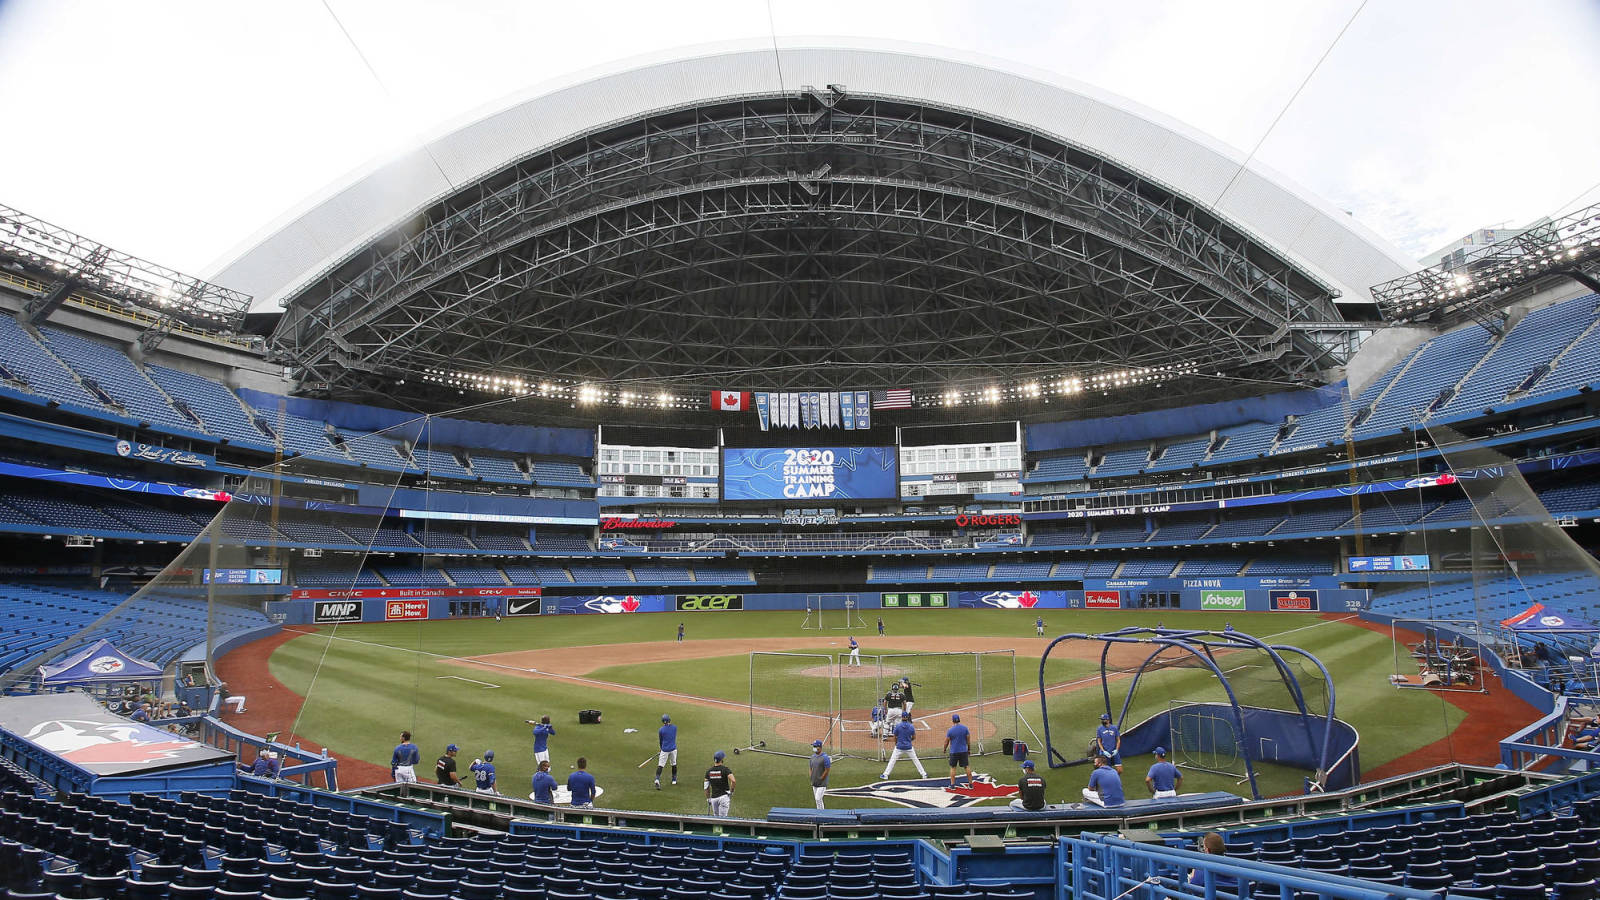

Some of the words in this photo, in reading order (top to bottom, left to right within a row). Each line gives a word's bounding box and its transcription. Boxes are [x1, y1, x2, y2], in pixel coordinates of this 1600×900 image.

[842, 408, 852, 416] 12
[856, 407, 869, 417] 32
[783, 449, 835, 466] 2020
[783, 465, 834, 475] SUMMER
[783, 475, 835, 484] TRAINING
[783, 483, 835, 498] CAMP
[1087, 509, 1115, 517] SUMMER
[600, 517, 677, 530] Budweiser
[971, 514, 1021, 526] ROGERS
[1183, 579, 1203, 588] PIZZA
[681, 594, 738, 610] acer
[888, 596, 898, 605] TD
[1087, 595, 1097, 604] Tim
[1096, 595, 1118, 604] Hortons
[1203, 593, 1243, 608] Sobeys
[320, 603, 357, 617] MNP
[474, 770, 487, 782] 28
